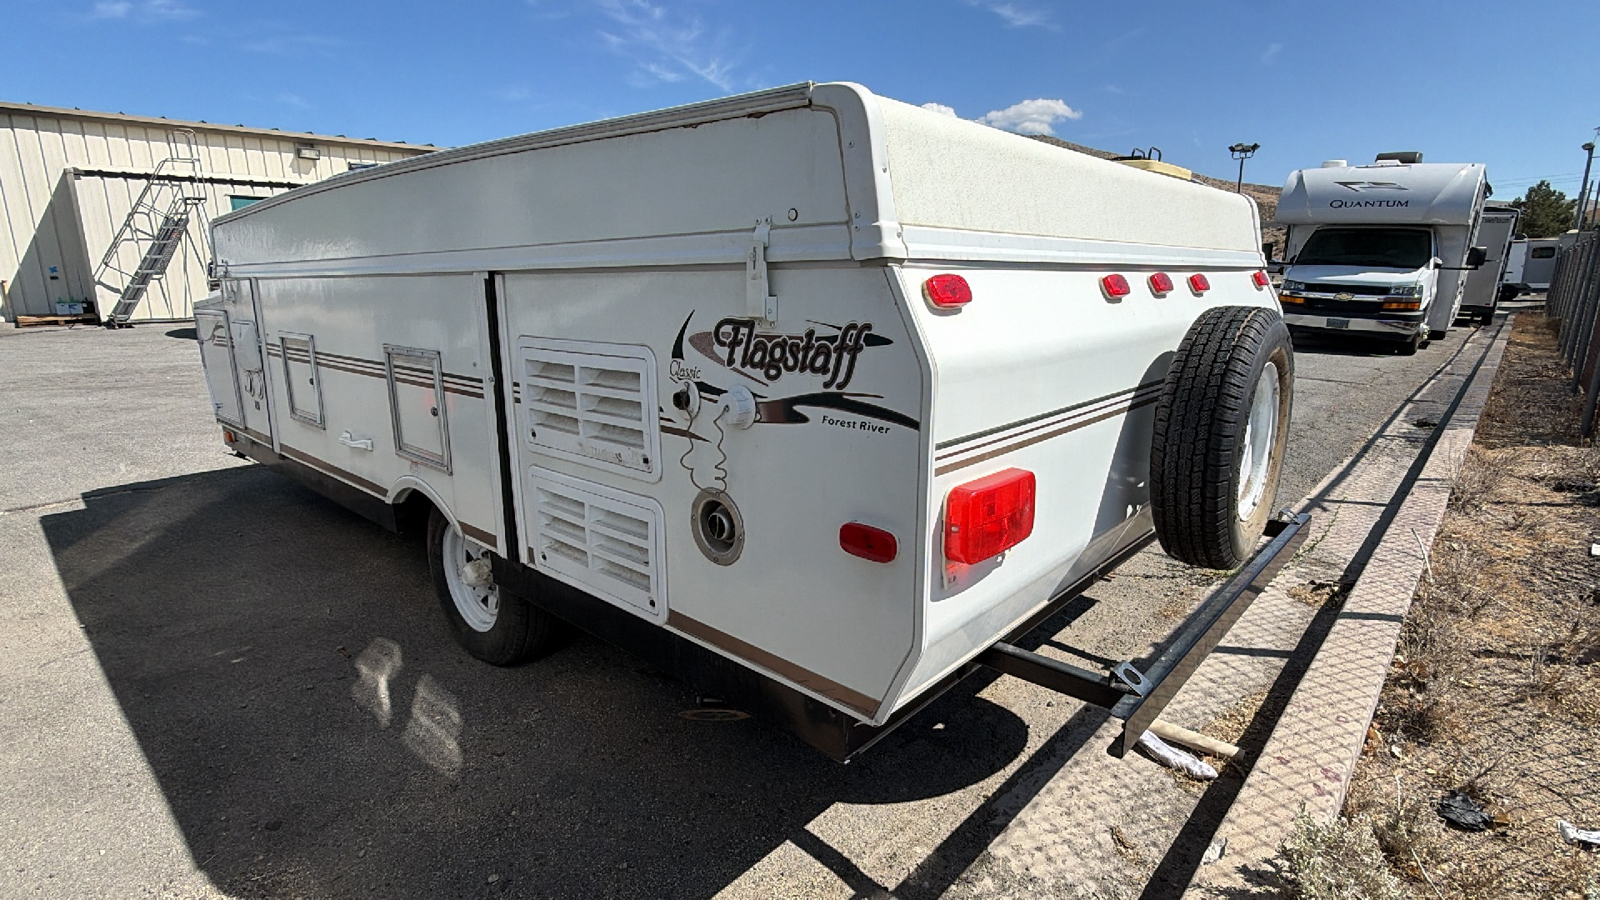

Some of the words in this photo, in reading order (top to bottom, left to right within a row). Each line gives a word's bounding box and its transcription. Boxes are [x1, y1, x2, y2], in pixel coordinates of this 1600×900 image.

[1329, 199, 1409, 209] QUANTUM
[713, 317, 873, 391] Flagstaff
[669, 359, 701, 379] Classic
[821, 415, 857, 429] Forest
[859, 421, 891, 434] River
